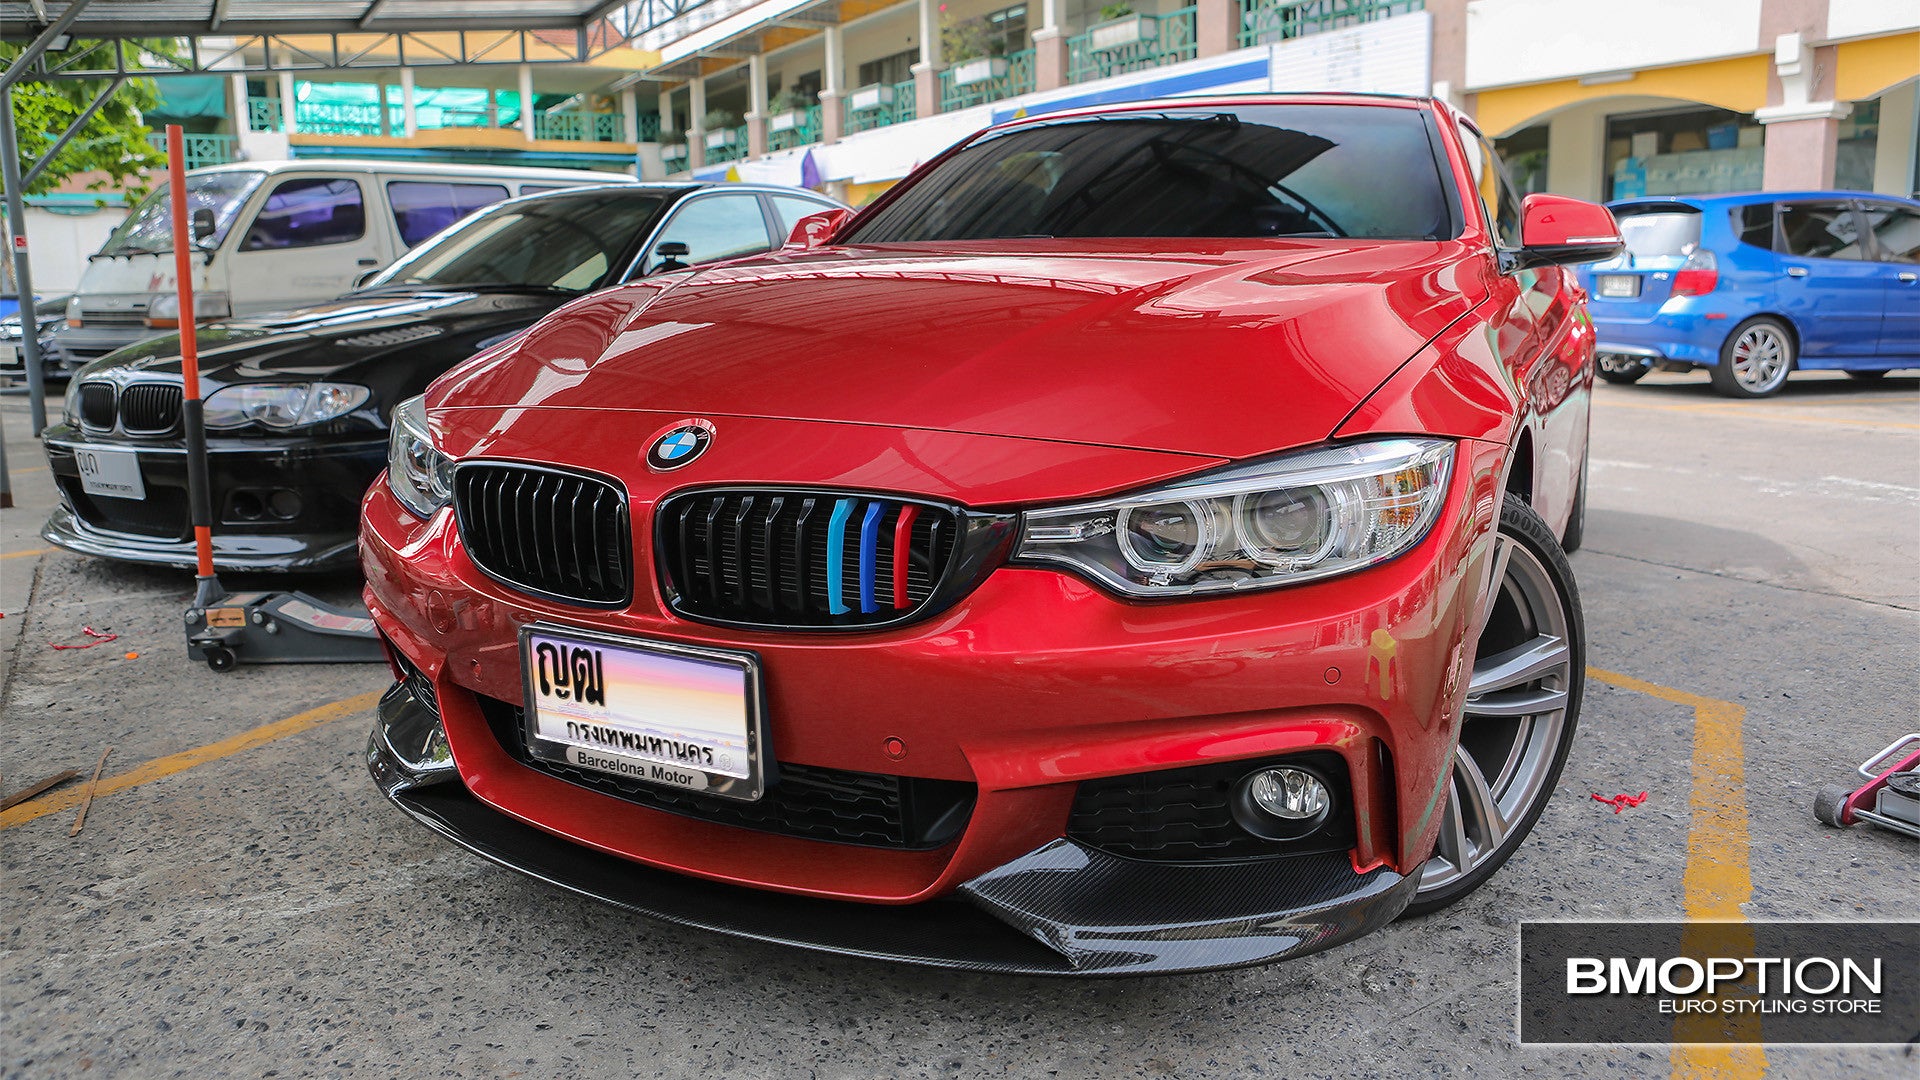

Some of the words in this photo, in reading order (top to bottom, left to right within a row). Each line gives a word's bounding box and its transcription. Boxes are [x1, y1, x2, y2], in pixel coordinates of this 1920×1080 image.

[566, 721, 714, 765] กรงเทพมหานคร
[577, 751, 645, 777] Barcelona
[651, 765, 694, 785] Motor
